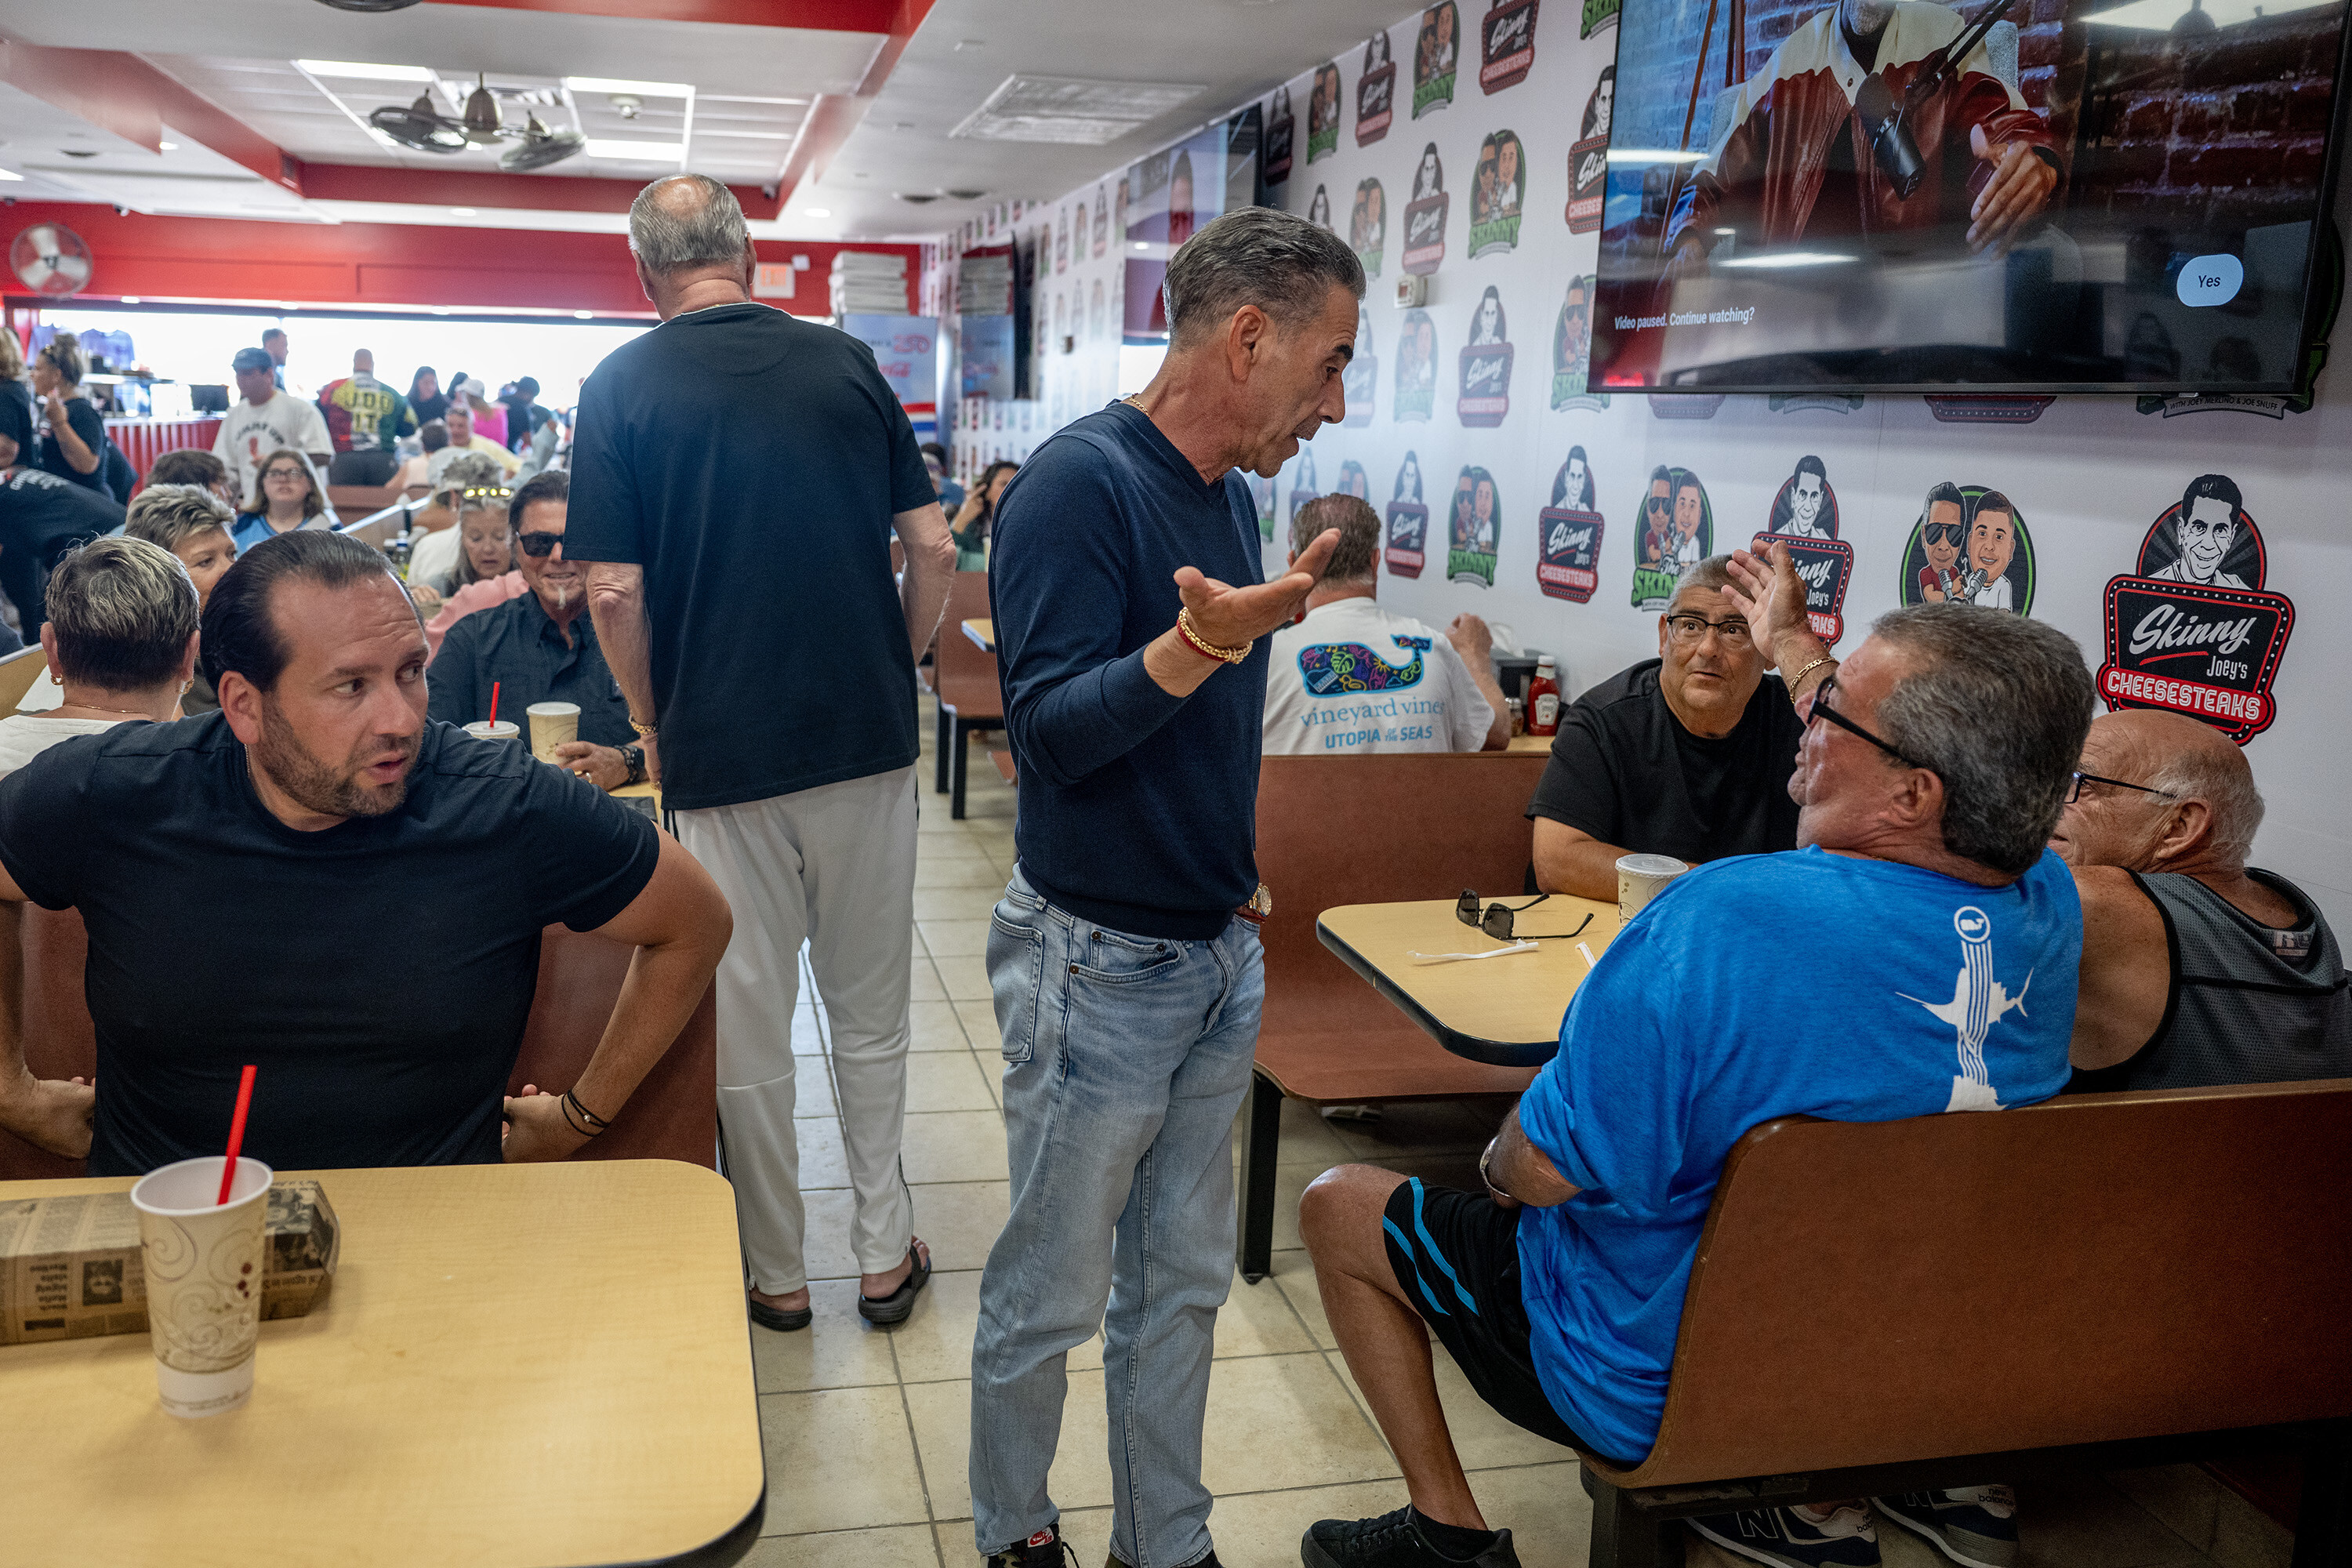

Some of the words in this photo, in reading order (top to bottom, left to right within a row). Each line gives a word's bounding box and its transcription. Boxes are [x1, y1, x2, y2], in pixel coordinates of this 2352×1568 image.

[2198, 274, 2221, 289] Yes
[1614, 315, 1636, 330] Video
[1637, 313, 1668, 332] paused.
[1669, 310, 1707, 326] Continue
[1708, 306, 1755, 325] watching?
[2169, 401, 2186, 410] WITH
[2187, 397, 2204, 407] JOEY
[2241, 397, 2256, 406] JOE
[2256, 401, 2279, 411] SNUFF
[1548, 521, 1593, 555] Skinny
[1660, 555, 1680, 575] The
[1632, 569, 1679, 604] SKIN
[1806, 589, 1829, 608] Joey's
[2129, 604, 2257, 655] Skinny
[2206, 655, 2249, 681] Joey's
[2107, 670, 2261, 720] CHEESESTEAKS
[1300, 697, 1398, 727] vineyard
[1325, 728, 1381, 749] UTOPIA
[1399, 725, 1433, 742] SEAS
